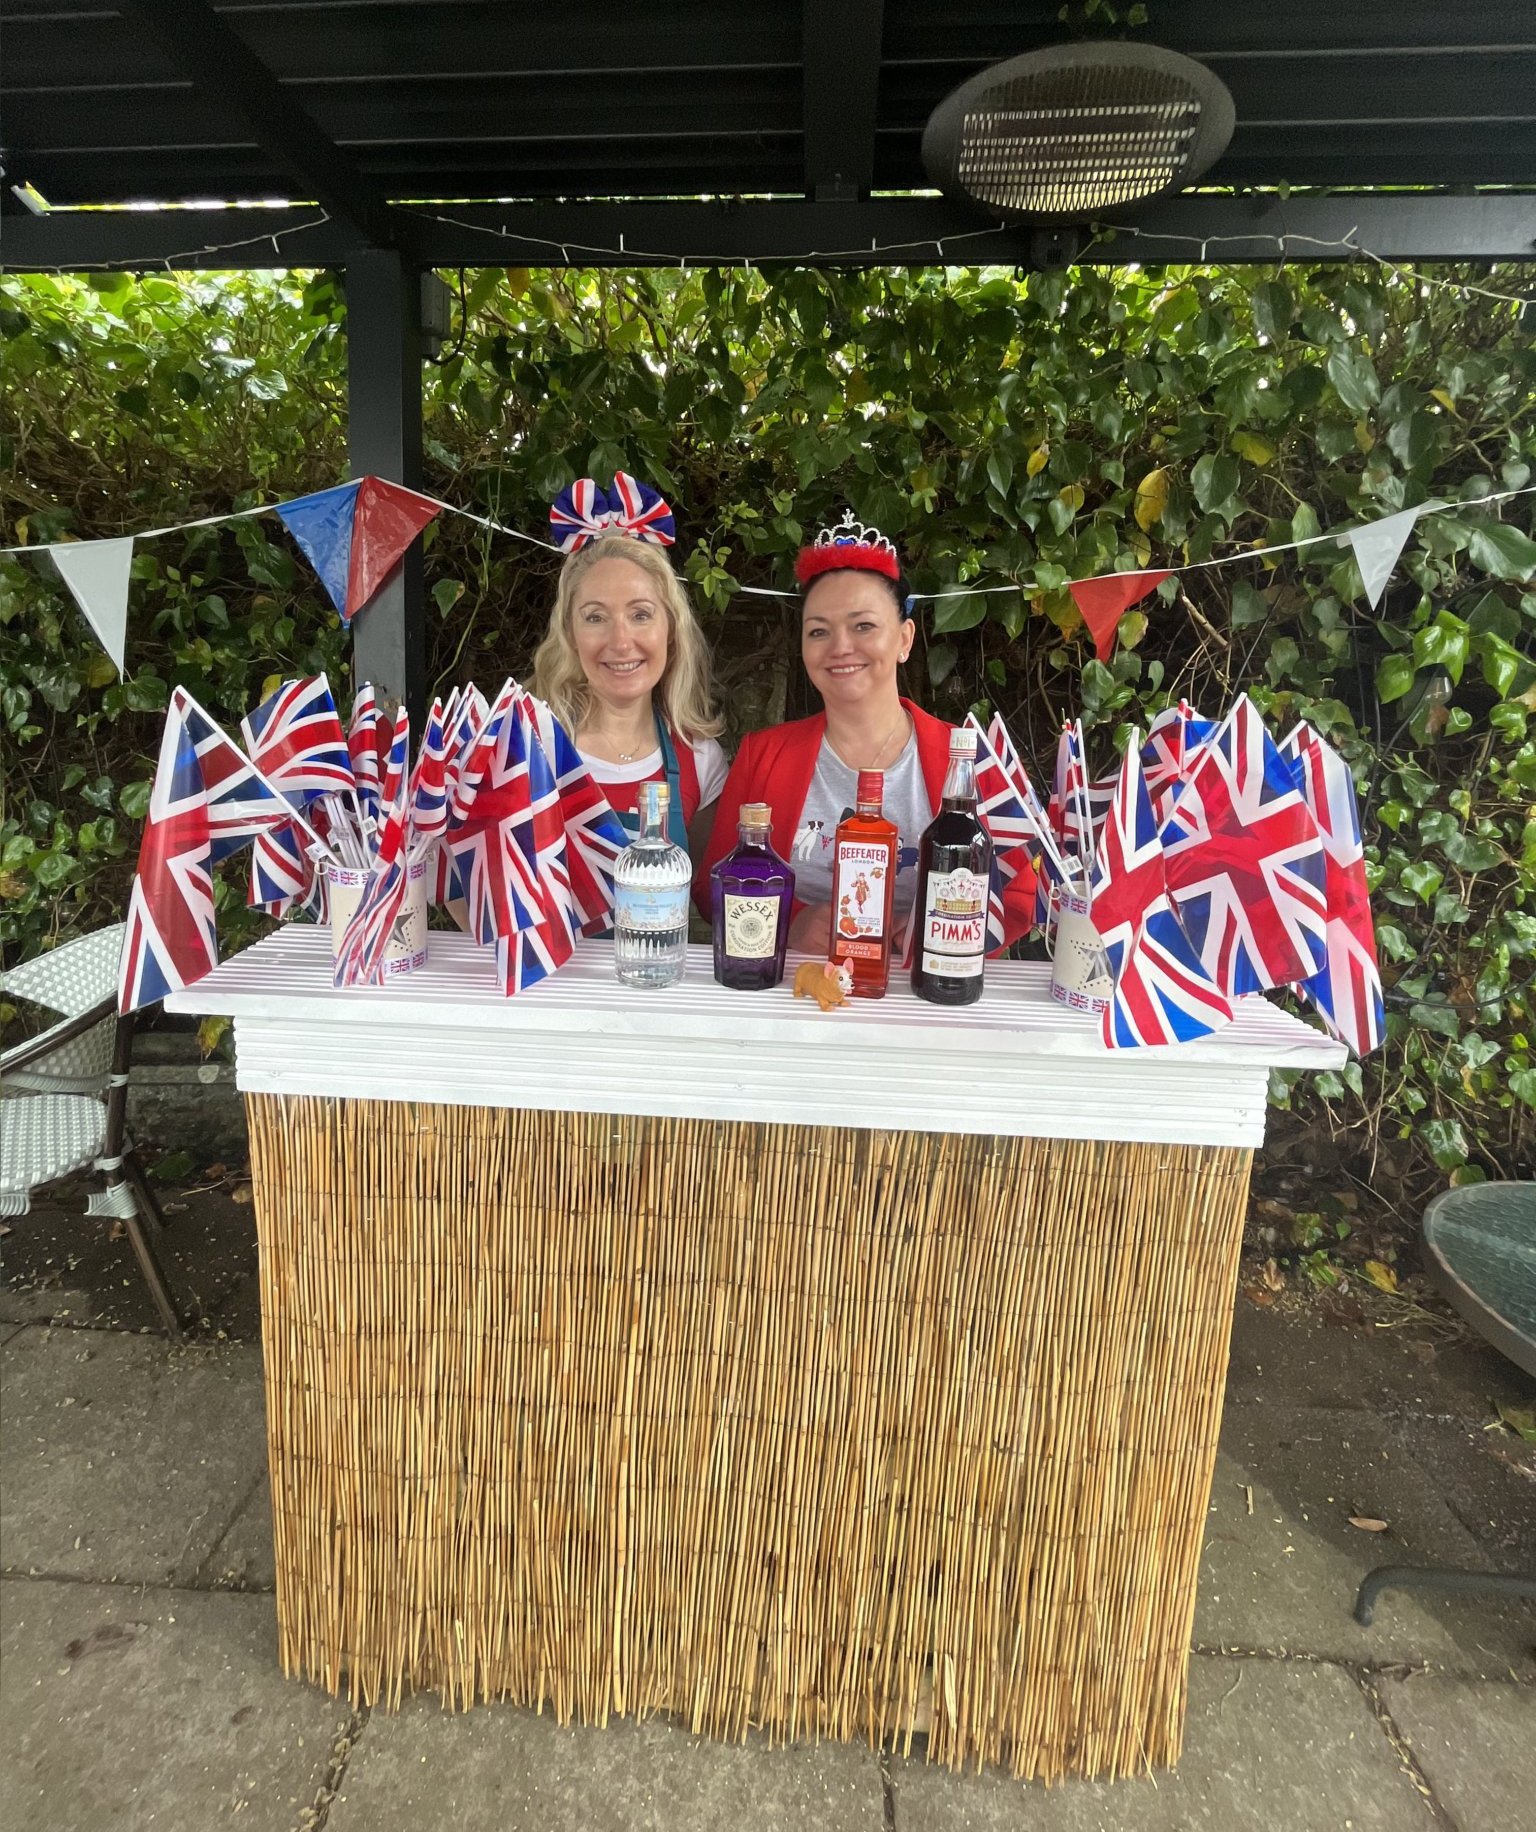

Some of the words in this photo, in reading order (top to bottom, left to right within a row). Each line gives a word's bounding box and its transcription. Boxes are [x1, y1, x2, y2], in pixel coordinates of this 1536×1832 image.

[840, 847, 886, 863] BEEFEATER
[730, 901, 774, 921] WESSEX
[931, 920, 981, 941] PIMM'S
[730, 930, 757, 951] CORONATION
[848, 943, 869, 951] BLOOD
[845, 949, 871, 957] ORANGE
